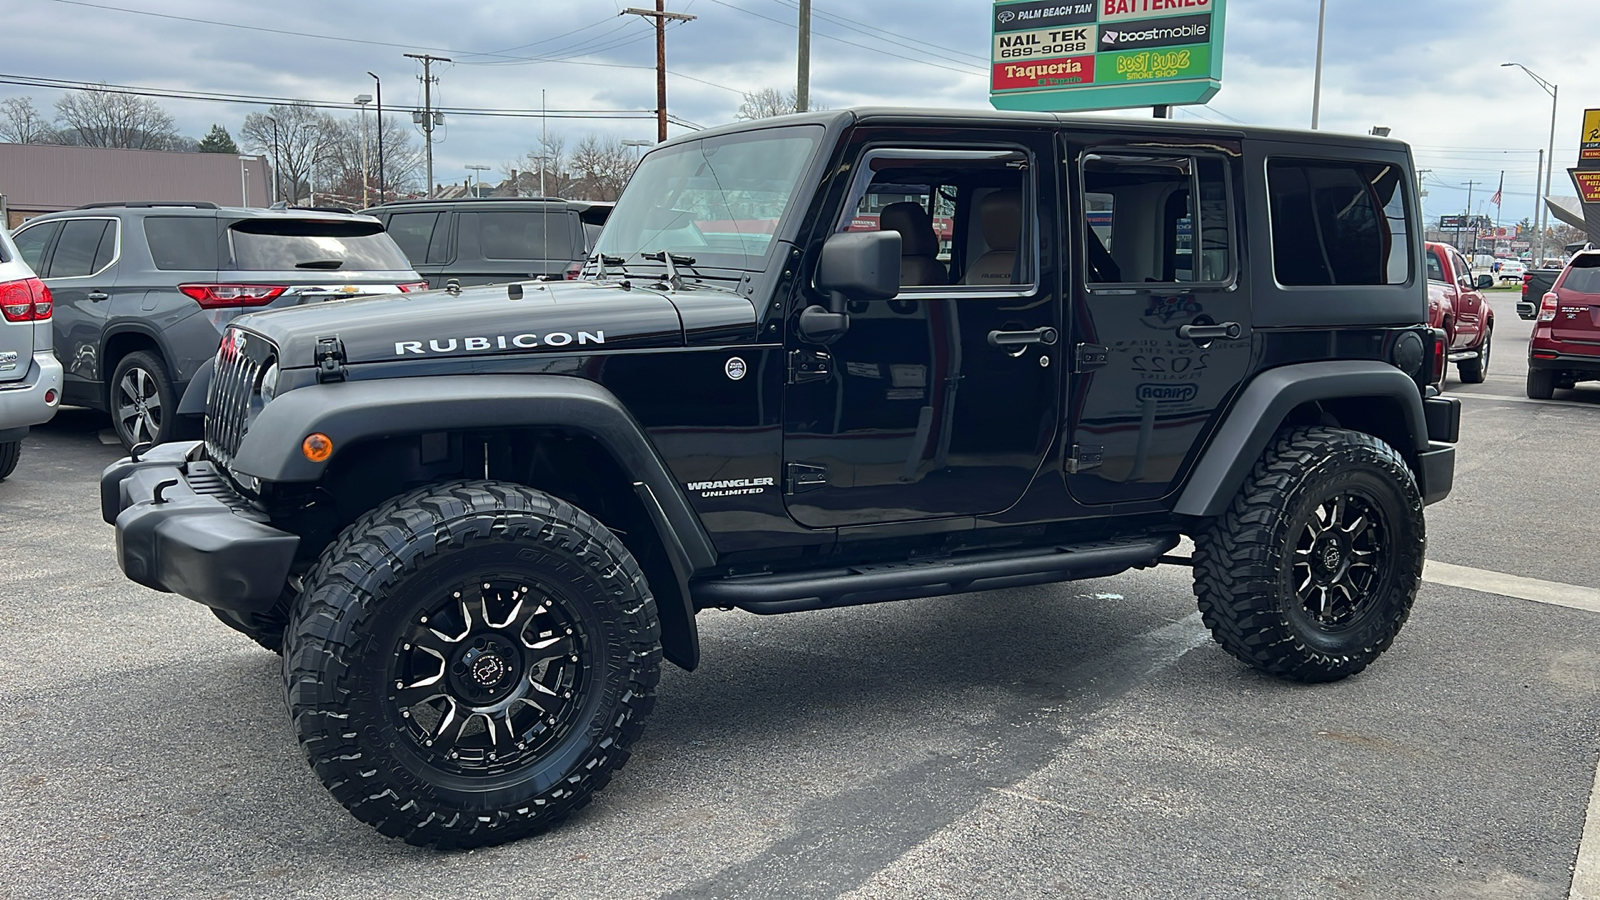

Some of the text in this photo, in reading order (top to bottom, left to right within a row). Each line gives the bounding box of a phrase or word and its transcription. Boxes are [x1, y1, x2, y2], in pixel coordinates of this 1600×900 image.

[1018, 3, 1092, 20] PALM BEACH TAN
[1000, 28, 1087, 48] NAIL TEK
[1001, 42, 1086, 58] 689-9088
[1127, 69, 1178, 80] SMOKE SHOP
[395, 330, 605, 355] RUBICON
[687, 476, 774, 491] WRANGLER
[702, 487, 764, 498] UNLIMITED
